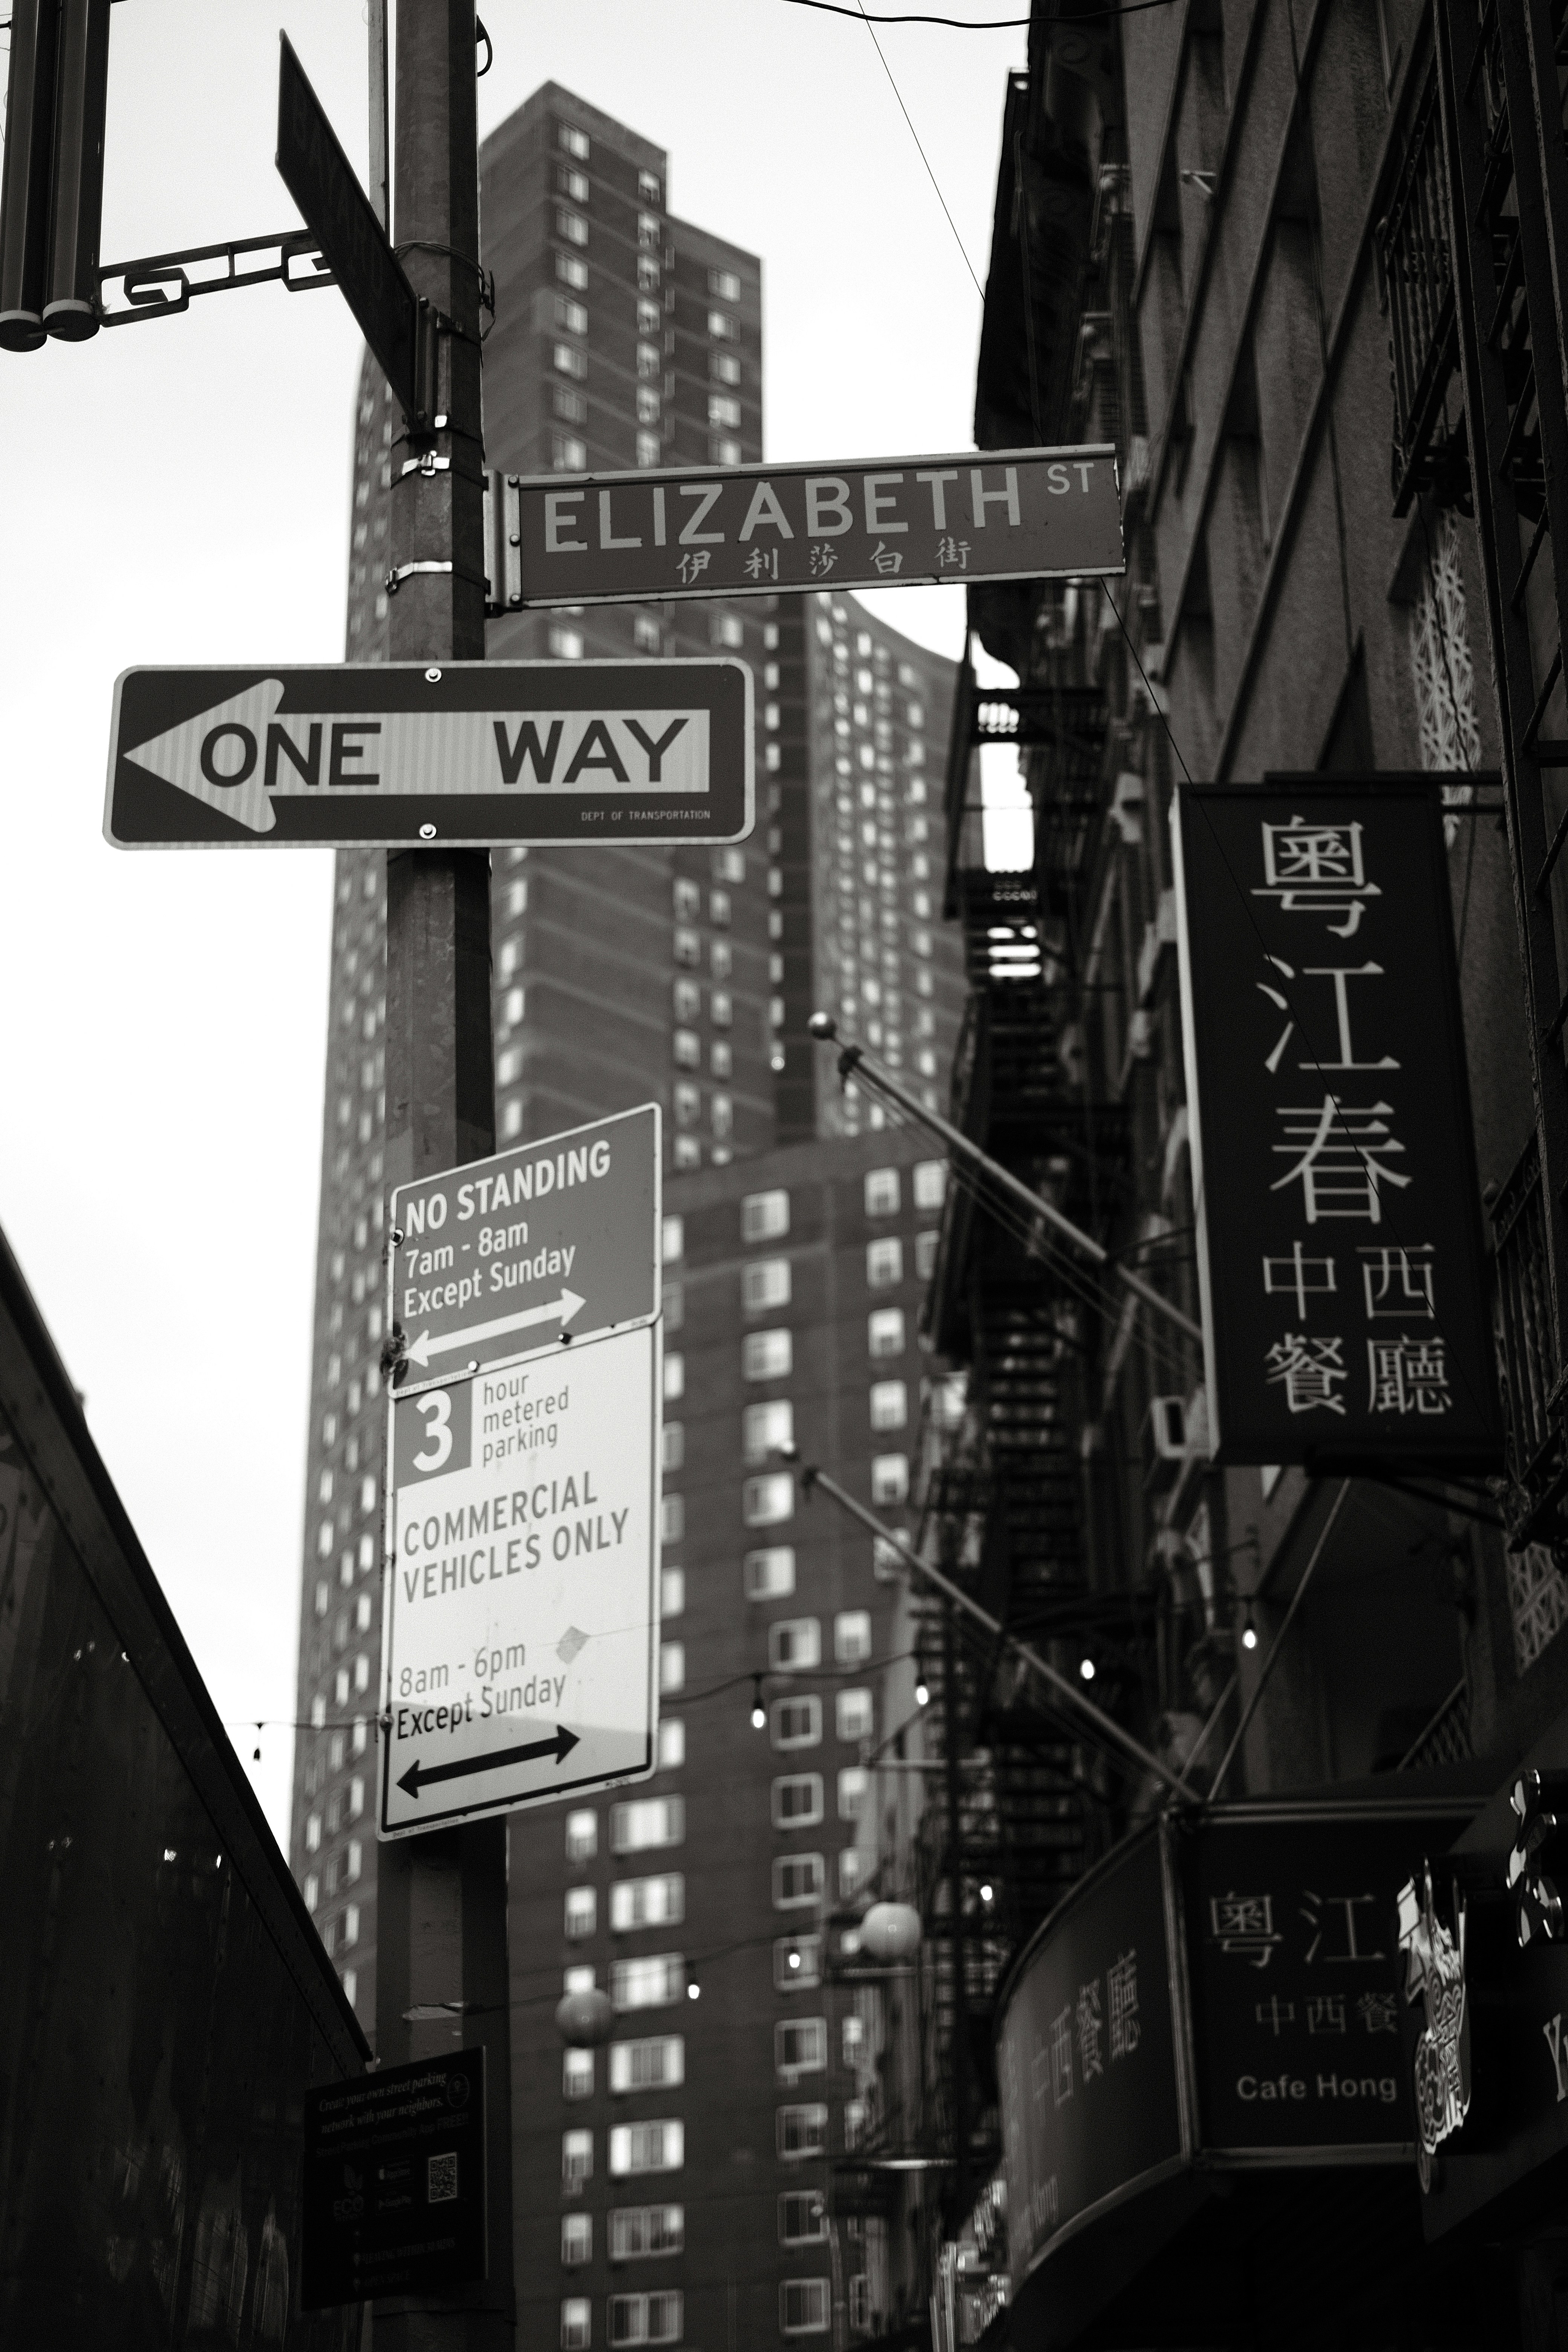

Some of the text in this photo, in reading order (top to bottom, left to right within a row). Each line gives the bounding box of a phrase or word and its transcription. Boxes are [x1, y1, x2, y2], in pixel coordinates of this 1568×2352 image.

[545, 462, 1095, 553] ELIZABETH ST
[677, 536, 972, 585] 伊利莎白街
[200, 718, 690, 788] ONE WAY
[581, 810, 710, 821] DEPT OF TRANSPORTATION
[406, 1139, 611, 1237] NO STANDING
[406, 1244, 453, 1279] 7am
[479, 1221, 528, 1257] 8am
[404, 1245, 576, 1318] Except Sunday
[1263, 1241, 1435, 1320] 中西
[483, 1374, 530, 1405] hour
[484, 1385, 570, 1433] metered
[412, 1389, 453, 1472] 3
[483, 1422, 558, 1468] parking
[404, 1470, 598, 1557] COMMERCIAL
[403, 1508, 629, 1603] VEHICLES ONLY
[399, 1662, 450, 1698] 8am
[474, 1642, 526, 1681] 6pm
[397, 1674, 567, 1740] Except Sunday
[345, 2092, 366, 2111] your
[366, 2087, 384, 2099] own
[386, 2081, 411, 2096] street
[411, 2072, 447, 2095] parking
[1237, 2073, 1398, 2103] Cafe Hong
[321, 2114, 355, 2134] network
[357, 2109, 375, 2125] with
[375, 2107, 397, 2126] your
